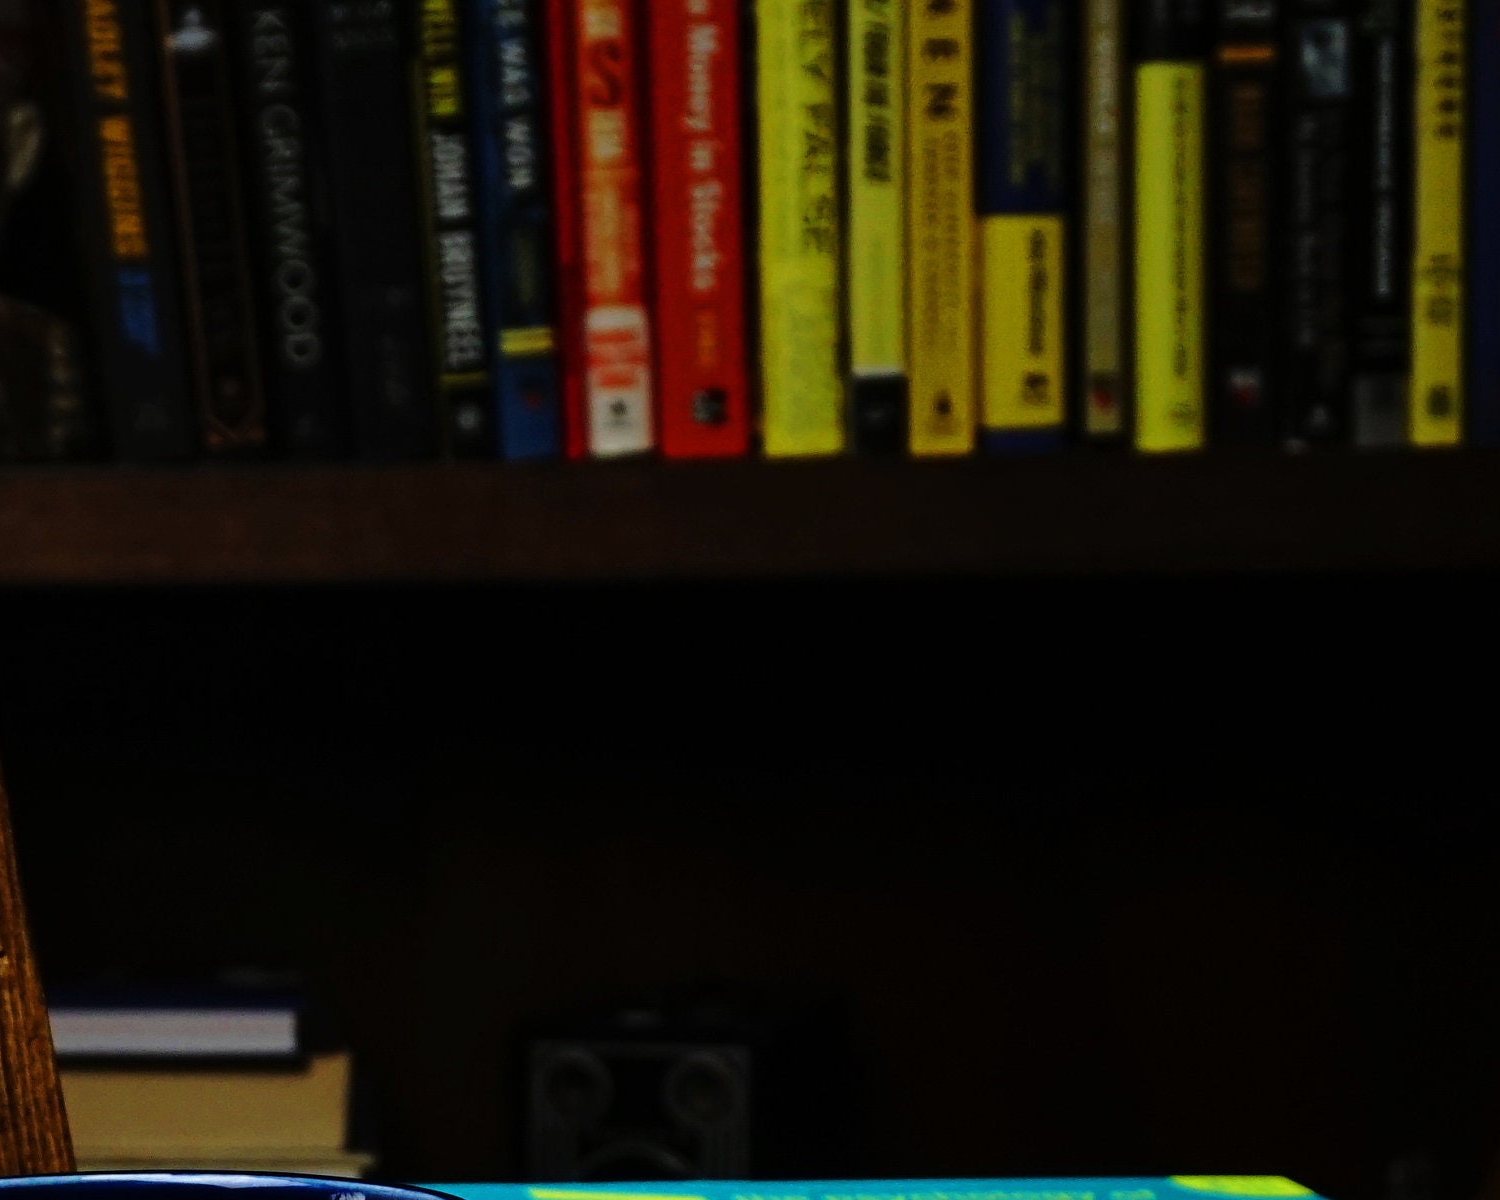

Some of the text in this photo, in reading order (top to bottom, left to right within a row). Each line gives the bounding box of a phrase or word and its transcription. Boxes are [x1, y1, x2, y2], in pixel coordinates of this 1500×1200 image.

[498, 36, 531, 108] WAS
[681, 21, 721, 132] Money
[253, 9, 322, 370] KEN GRIMWOOD
[503, 114, 535, 193] WON
[687, 137, 720, 172] in
[430, 129, 486, 370] JOHAN BRUYNEEL
[688, 180, 724, 293] Stocks
[1110, 1188, 1157, 1200] of
